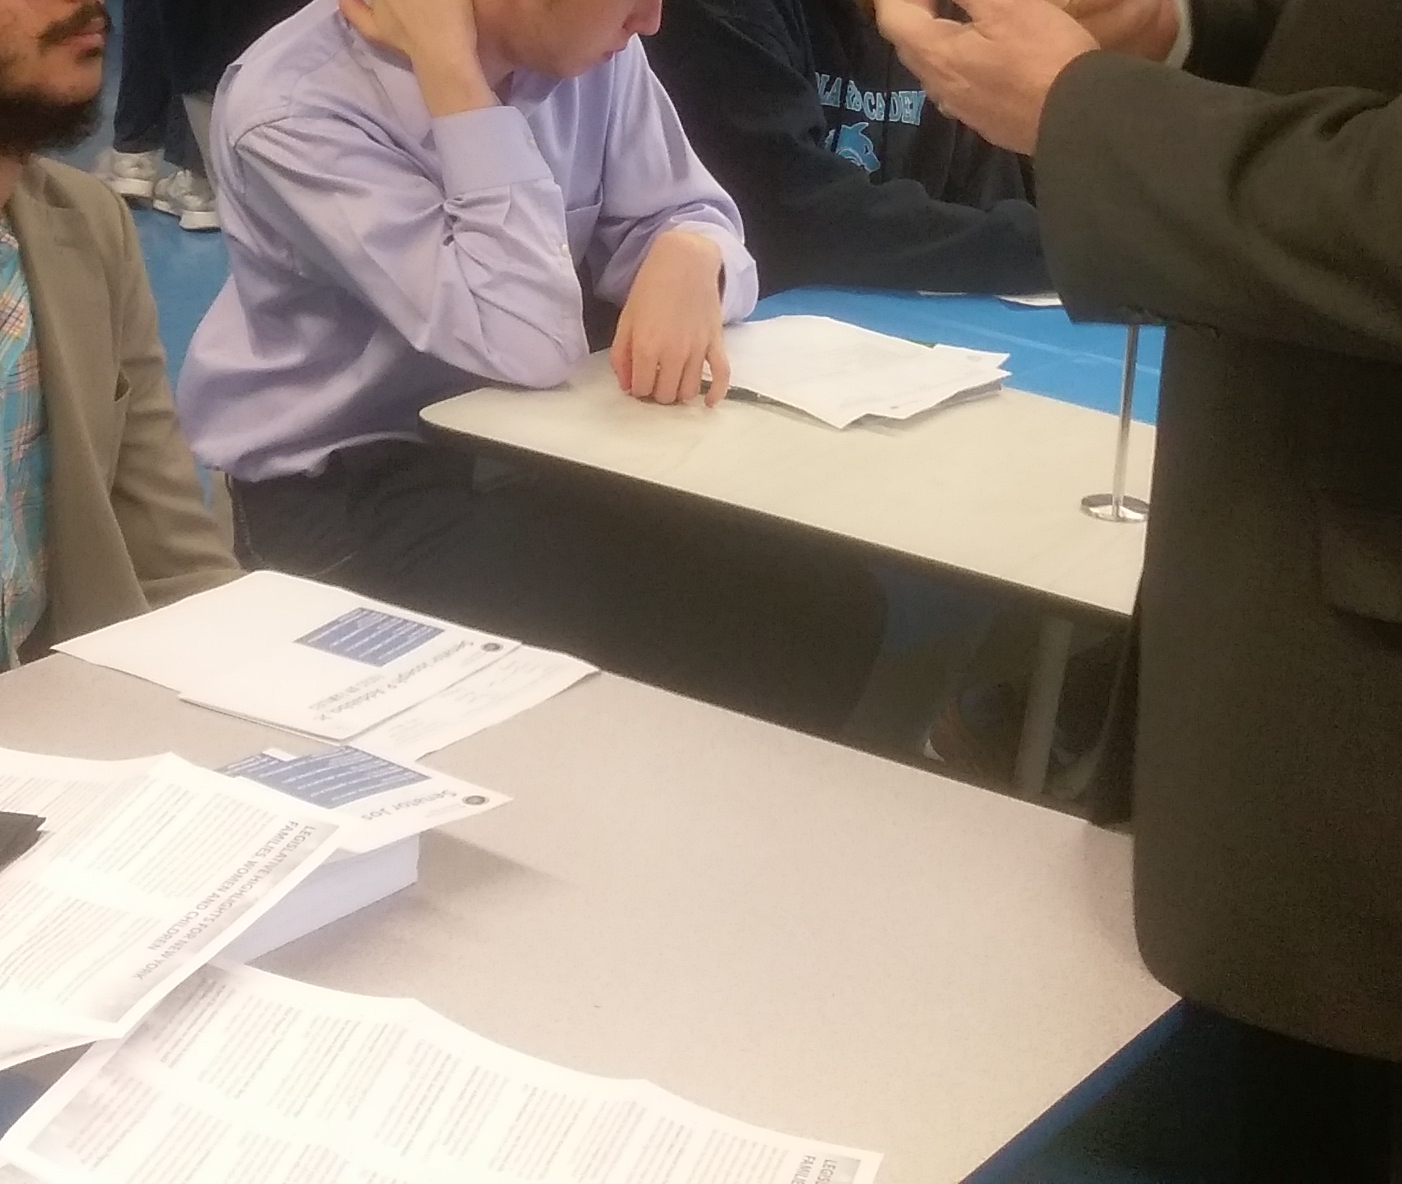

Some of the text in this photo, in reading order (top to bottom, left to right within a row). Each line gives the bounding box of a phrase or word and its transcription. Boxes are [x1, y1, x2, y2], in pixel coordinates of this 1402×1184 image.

[360, 807, 392, 820] Jos
[216, 859, 258, 894] WOMEN
[131, 825, 317, 980] LEGISLATIVE HIGHLIGHTS FOR NEW YORK
[195, 892, 221, 911] AND
[147, 910, 200, 951] CHILDREN
[814, 1159, 838, 1184] LEGIS
